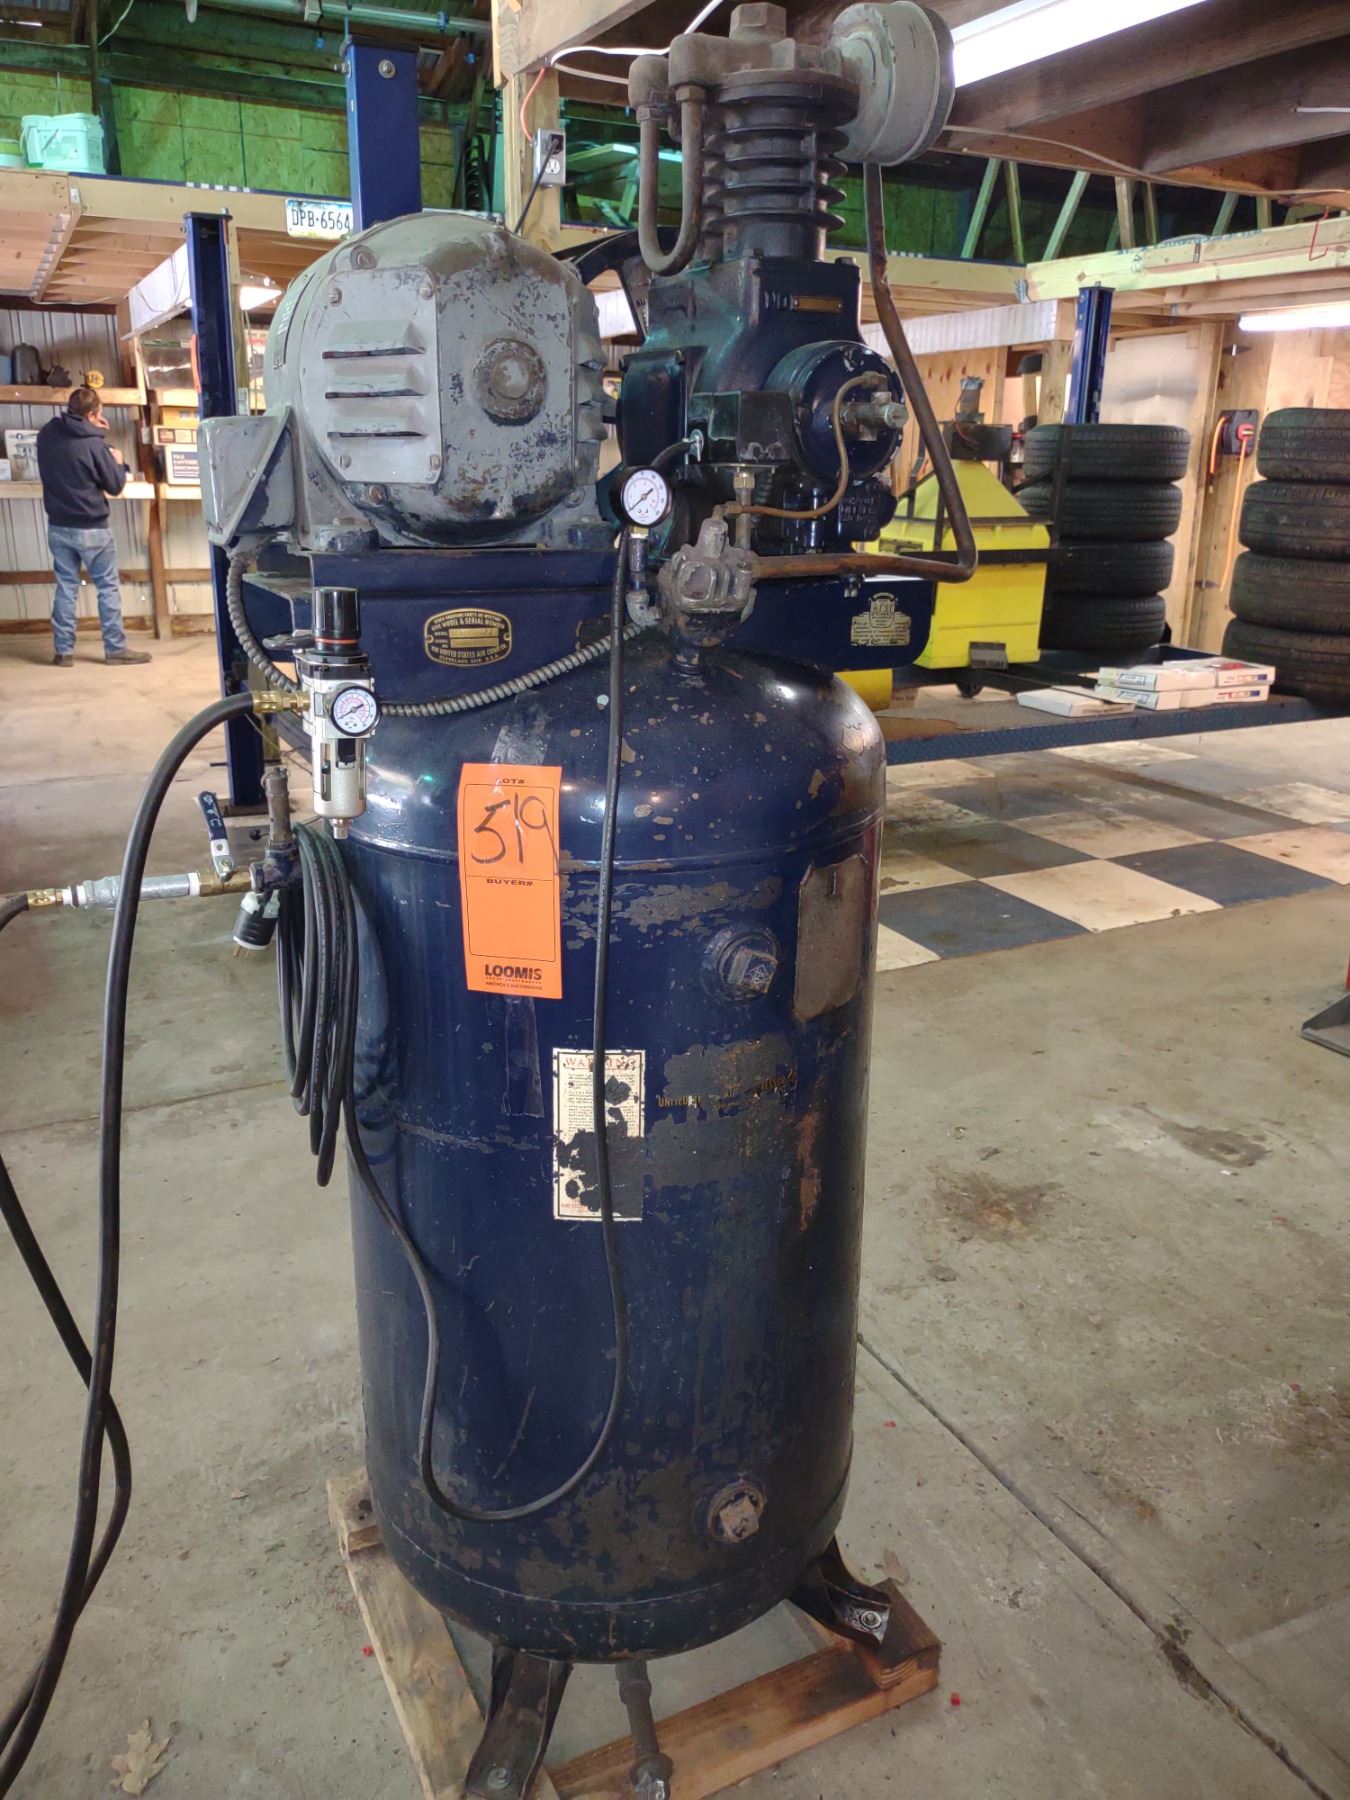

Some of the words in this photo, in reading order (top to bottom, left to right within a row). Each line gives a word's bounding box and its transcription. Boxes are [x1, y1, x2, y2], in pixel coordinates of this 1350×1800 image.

[471, 791, 560, 875] 519
[486, 878, 533, 887] BUYER#
[485, 964, 542, 981] LOOMIS
